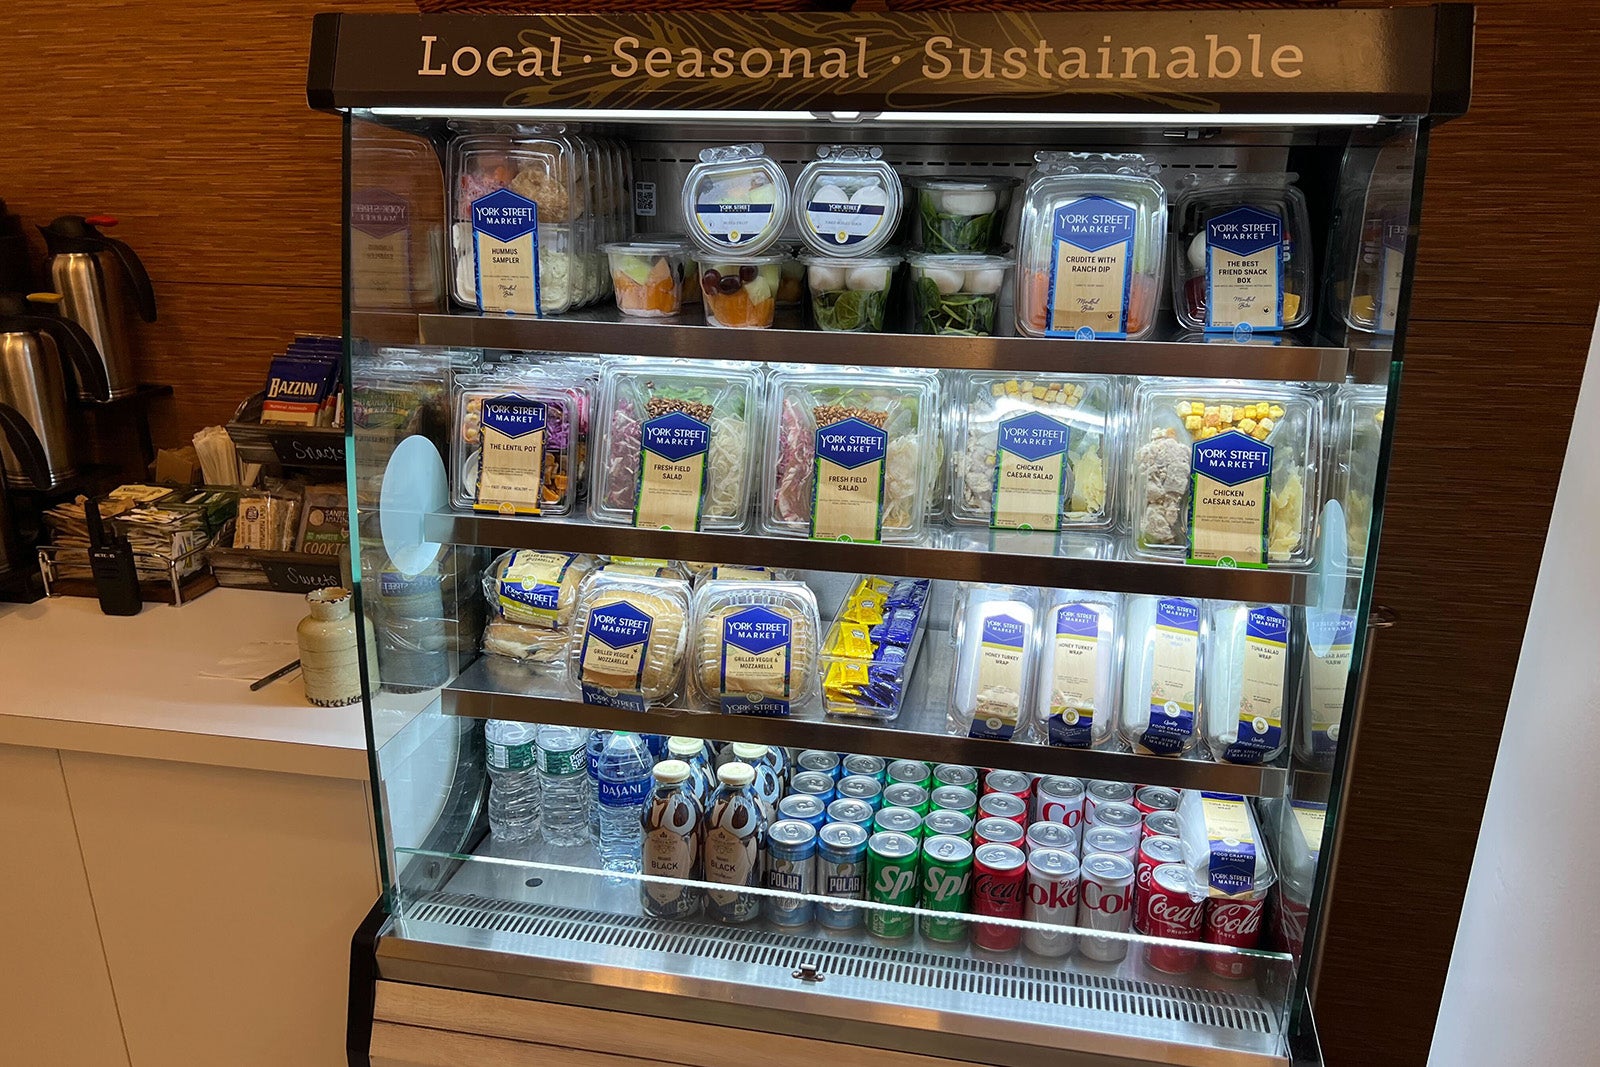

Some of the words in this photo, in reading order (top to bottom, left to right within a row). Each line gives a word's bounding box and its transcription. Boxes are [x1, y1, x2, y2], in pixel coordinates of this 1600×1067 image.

[418, 36, 562, 77] Local
[611, 36, 868, 79] Seasonal
[921, 34, 1304, 80] Sustainable
[719, 204, 733, 212] YORK
[476, 207, 500, 221] YORK
[502, 207, 533, 222] STREET
[1060, 214, 1088, 229] YORK
[1092, 215, 1129, 230] STREET
[1071, 225, 1117, 233] MARKET
[1211, 224, 1239, 237] YORK
[1241, 224, 1277, 236] STREET
[492, 256, 519, 264] SAMPLER
[1097, 256, 1116, 264] WITH
[1071, 265, 1097, 273] RANCH
[1098, 265, 1110, 273] DIP
[267, 378, 318, 398] BAZZINI
[486, 404, 510, 418] YORK
[512, 406, 544, 421] STREET
[495, 414, 533, 423] MARKET
[647, 427, 671, 440] YORK
[674, 429, 706, 443] STREET
[1003, 427, 1029, 440] YORK
[1032, 429, 1065, 443] STREET
[656, 437, 695, 446] MARKET
[820, 434, 846, 448] YORK
[849, 436, 883, 450] STREET
[1013, 437, 1053, 446] MARKET
[292, 441, 345, 461] Snacks
[502, 444, 523, 452] LENTIL
[830, 445, 871, 453] MARKET
[1198, 448, 1227, 463] YORK
[1230, 450, 1267, 466] STREET
[1209, 460, 1254, 469] MARKET
[1006, 471, 1032, 479] CAESAR
[1213, 489, 1244, 497] CHICKEN
[1202, 498, 1231, 506] CAESAR
[1232, 499, 1256, 507] SALAD
[286, 567, 338, 586] Sweets
[523, 592, 554, 607] STREET
[1159, 602, 1176, 611] YORK
[1176, 605, 1198, 617] STREET
[1165, 609, 1190, 618] MARKET
[1059, 611, 1076, 619] YORK
[1250, 612, 1266, 621] YORK
[1266, 616, 1286, 628] STREET
[593, 613, 617, 627] YORK
[619, 618, 648, 634] STREET
[986, 620, 1002, 629] YORK
[1002, 622, 1022, 633] STREET
[1255, 620, 1279, 628] MARKET
[600, 624, 637, 636] MARKET
[727, 621, 753, 635] YORK
[755, 623, 788, 637] STREET
[737, 631, 777, 639] MARKET
[593, 648, 612, 656] GRILLED
[1251, 645, 1264, 653] TUNA
[597, 656, 629, 665] MOZZARELLA
[586, 692, 609, 703] YORK
[726, 704, 751, 714] YORK
[753, 704, 785, 714] STREET
[602, 784, 642, 798] DASANI
[1228, 852, 1254, 860] CRAFTED
[651, 861, 679, 870] BLACK
[710, 860, 736, 872] BLACK
[769, 871, 800, 890] POLAR
[1211, 872, 1229, 882] YORK
[1229, 874, 1251, 886] STREET
[1217, 879, 1244, 887] MARKET
[829, 877, 860, 893] POLAR
[1217, 929, 1236, 939] TASTE
